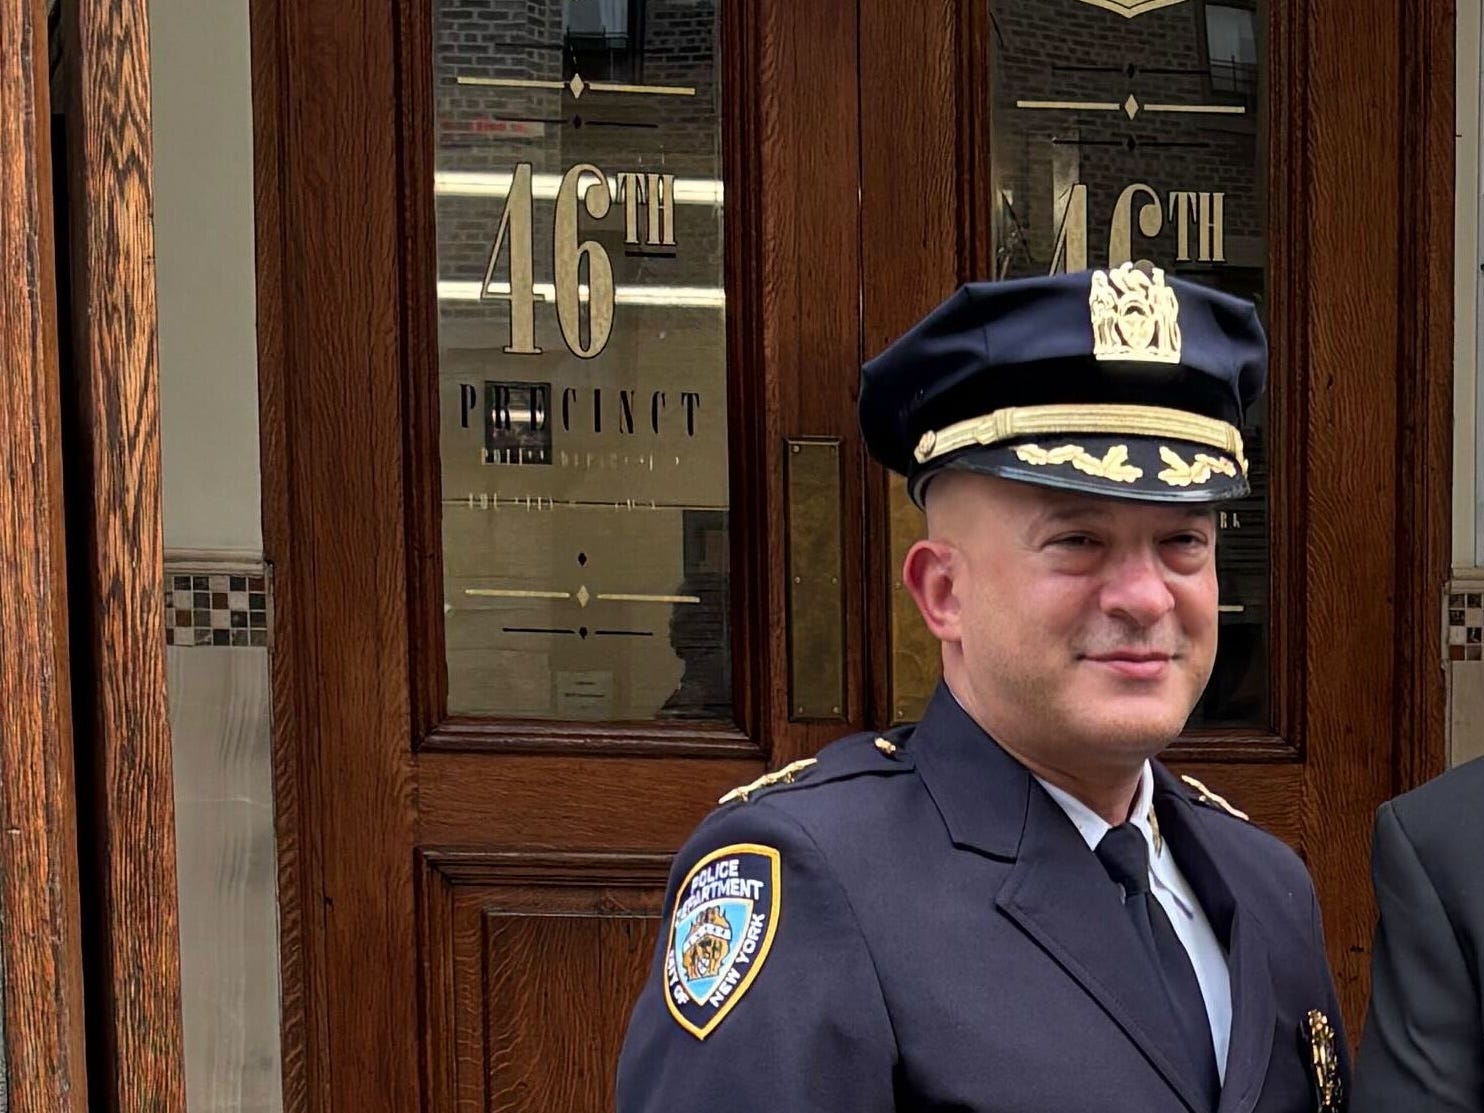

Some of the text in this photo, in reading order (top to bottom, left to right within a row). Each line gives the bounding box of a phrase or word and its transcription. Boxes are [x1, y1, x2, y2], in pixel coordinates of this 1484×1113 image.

[480, 162, 677, 358] 46TH
[690, 859, 740, 894] POLICE
[710, 912, 766, 1008] NEW YORK
